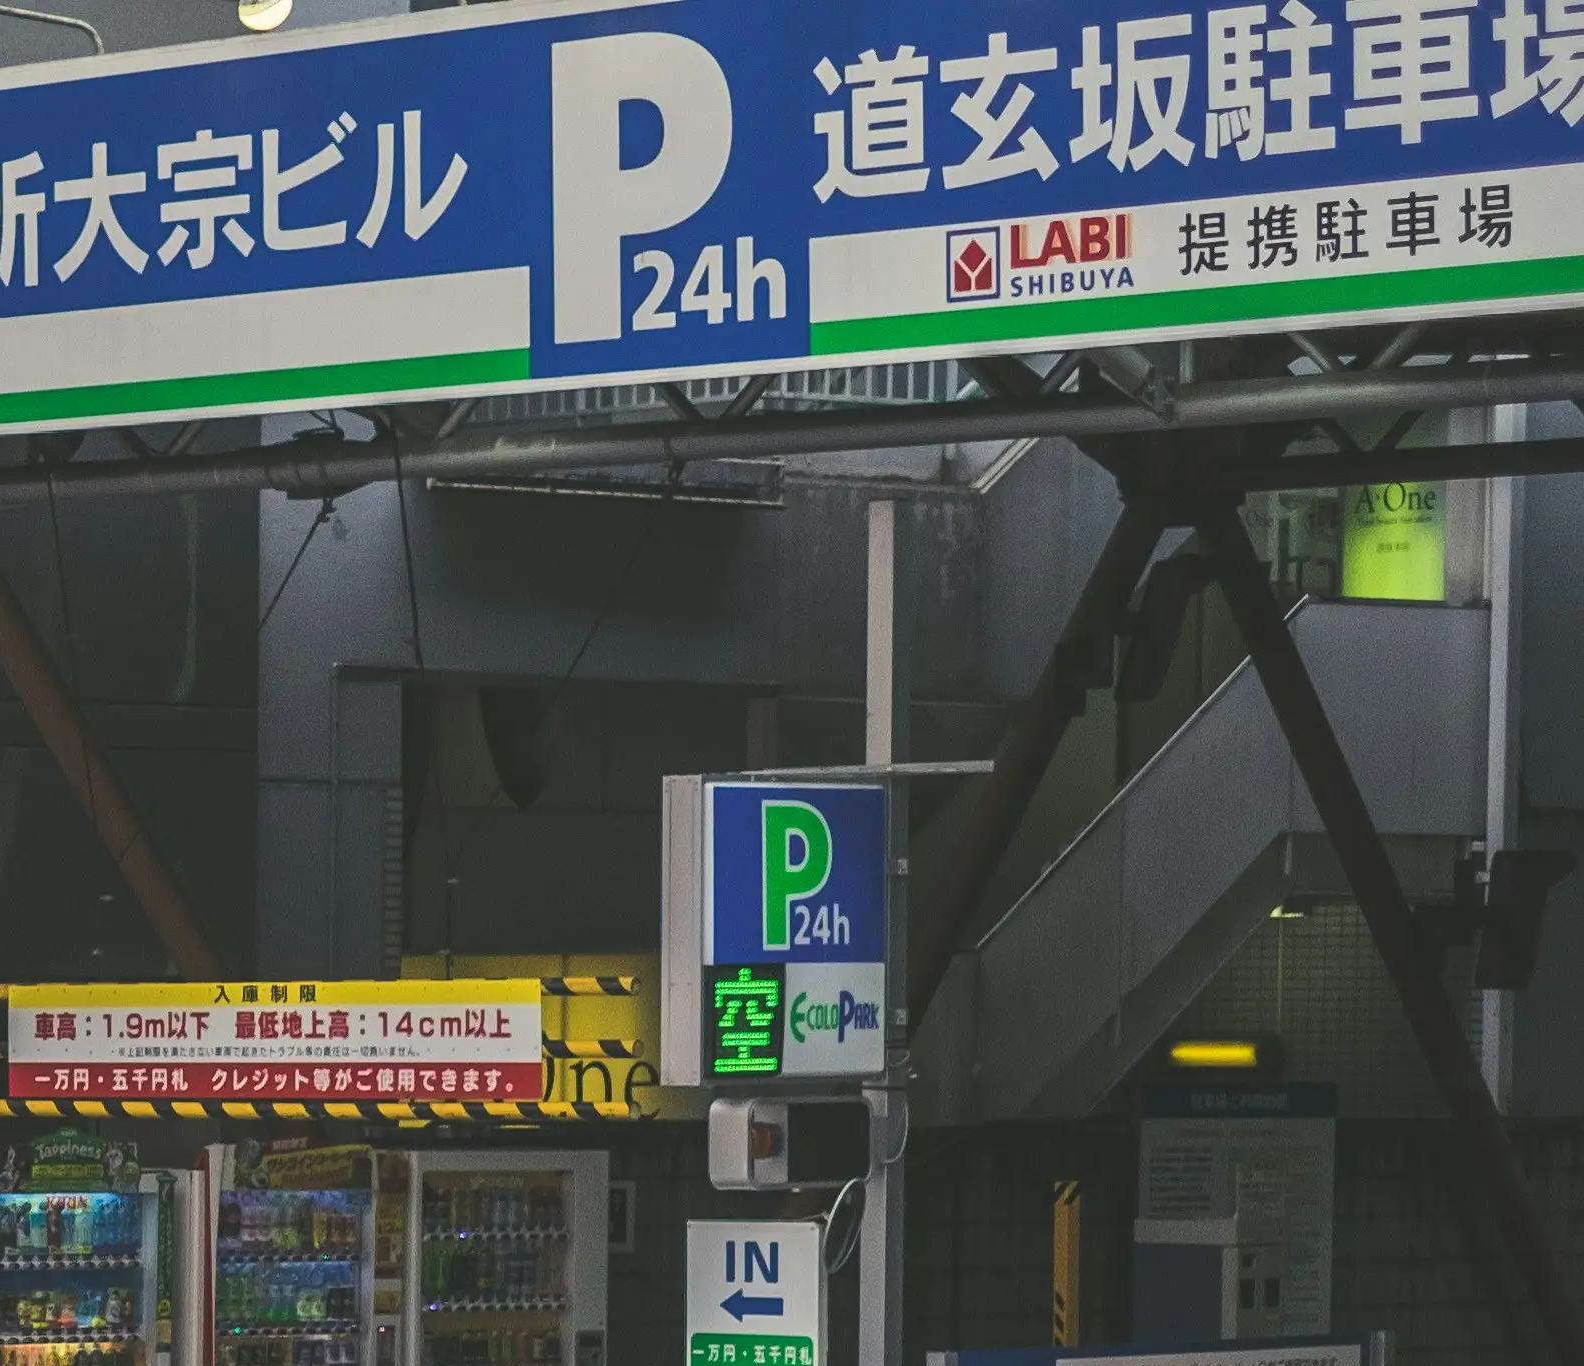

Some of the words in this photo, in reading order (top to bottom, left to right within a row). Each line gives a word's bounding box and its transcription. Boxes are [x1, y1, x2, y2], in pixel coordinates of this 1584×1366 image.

[812, 0, 1584, 204] 道玄坂駐車場
[550, 31, 733, 344] P
[1009, 212, 1133, 268] LABI
[1178, 183, 1513, 277] 提携駐車場
[632, 234, 787, 331] 24h
[1009, 266, 1135, 299] SHIBUYA
[762, 800, 832, 950] P
[794, 904, 850, 947] 24h
[214, 984, 317, 1004] 入庫制限
[714, 967, 779, 1074] 空
[34, 1068, 190, 1092] 一万円・五千円札
[726, 1241, 779, 1285] IN
